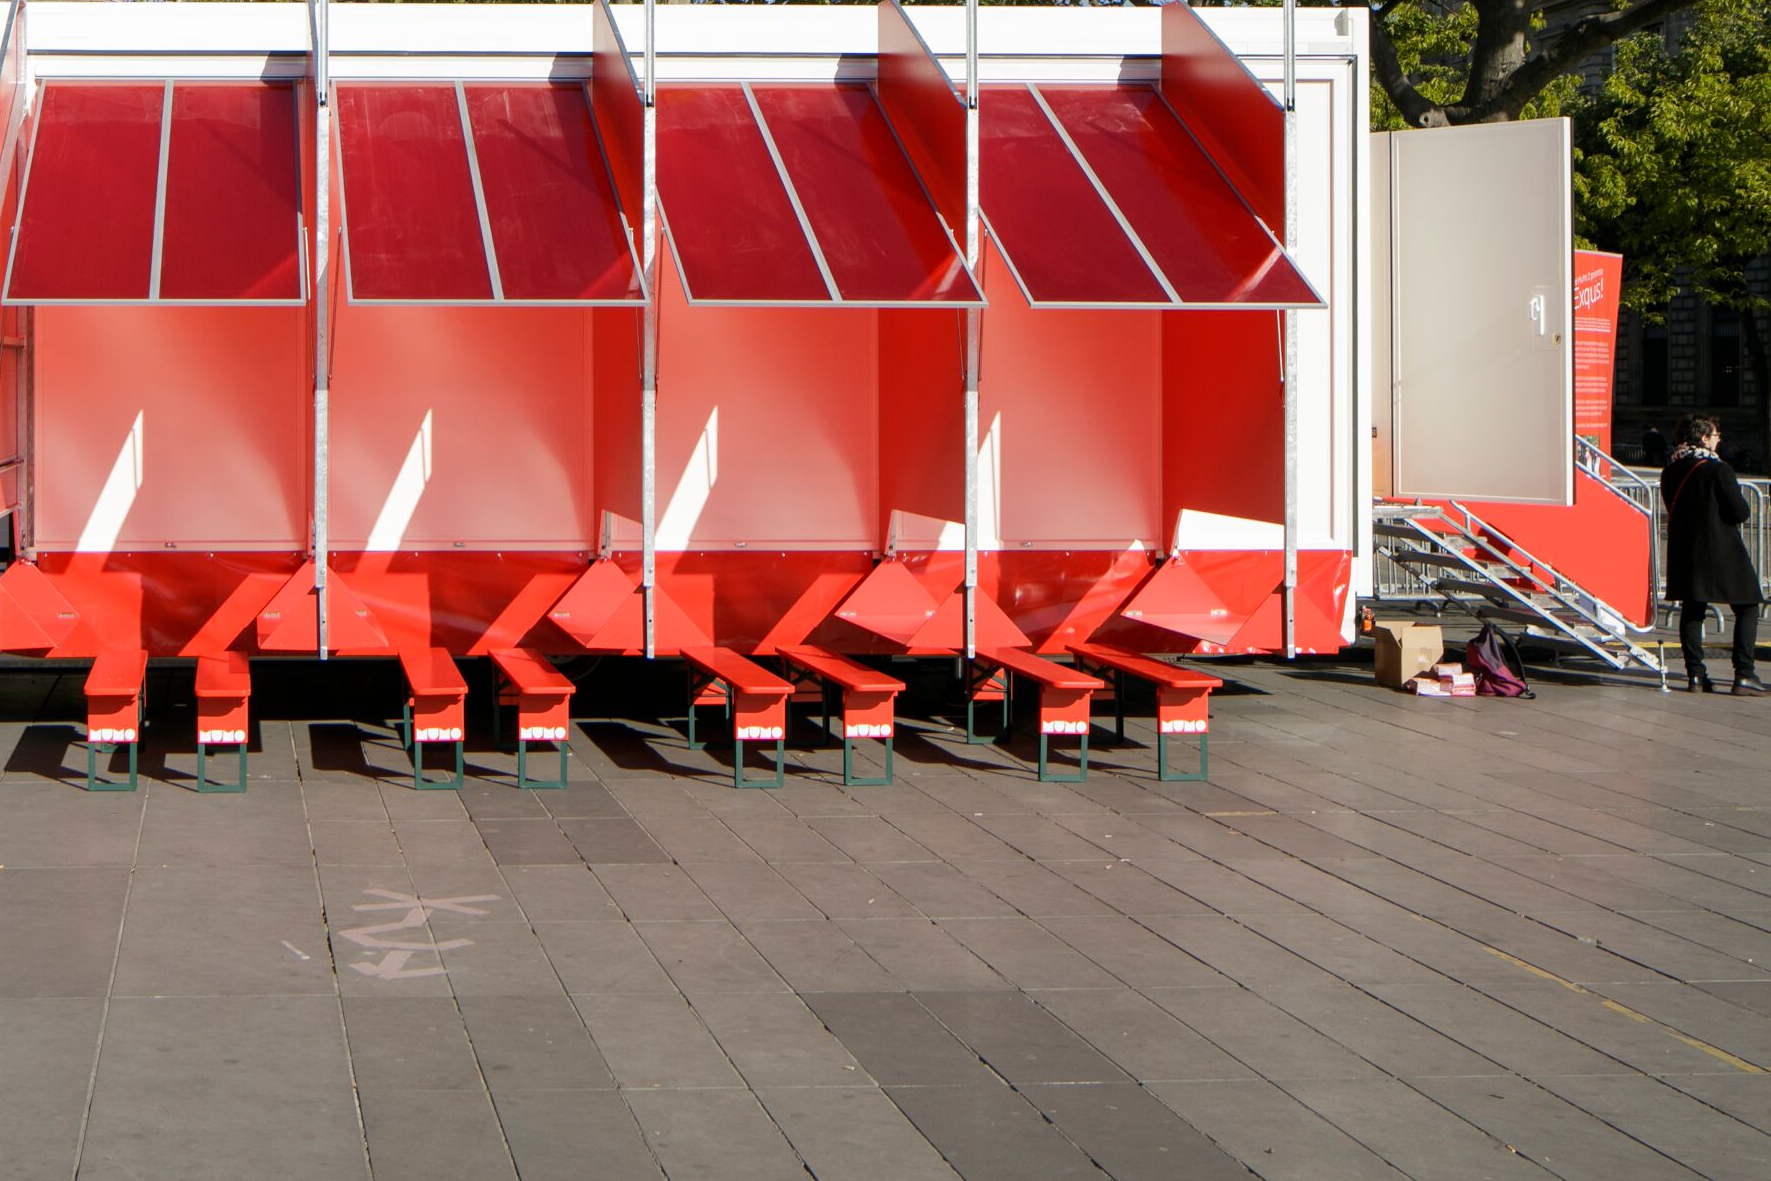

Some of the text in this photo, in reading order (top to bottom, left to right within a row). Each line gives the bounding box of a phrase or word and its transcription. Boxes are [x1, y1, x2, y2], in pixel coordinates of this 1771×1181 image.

[847, 725, 891, 736] MUMO
[1043, 721, 1087, 733] MUMO
[1162, 720, 1206, 732] MUMO
[90, 729, 135, 741] MUMO
[200, 730, 245, 742] MUMO
[416, 728, 461, 740] MUMO
[521, 727, 565, 739] MUMO
[738, 727, 782, 738] MUMO
